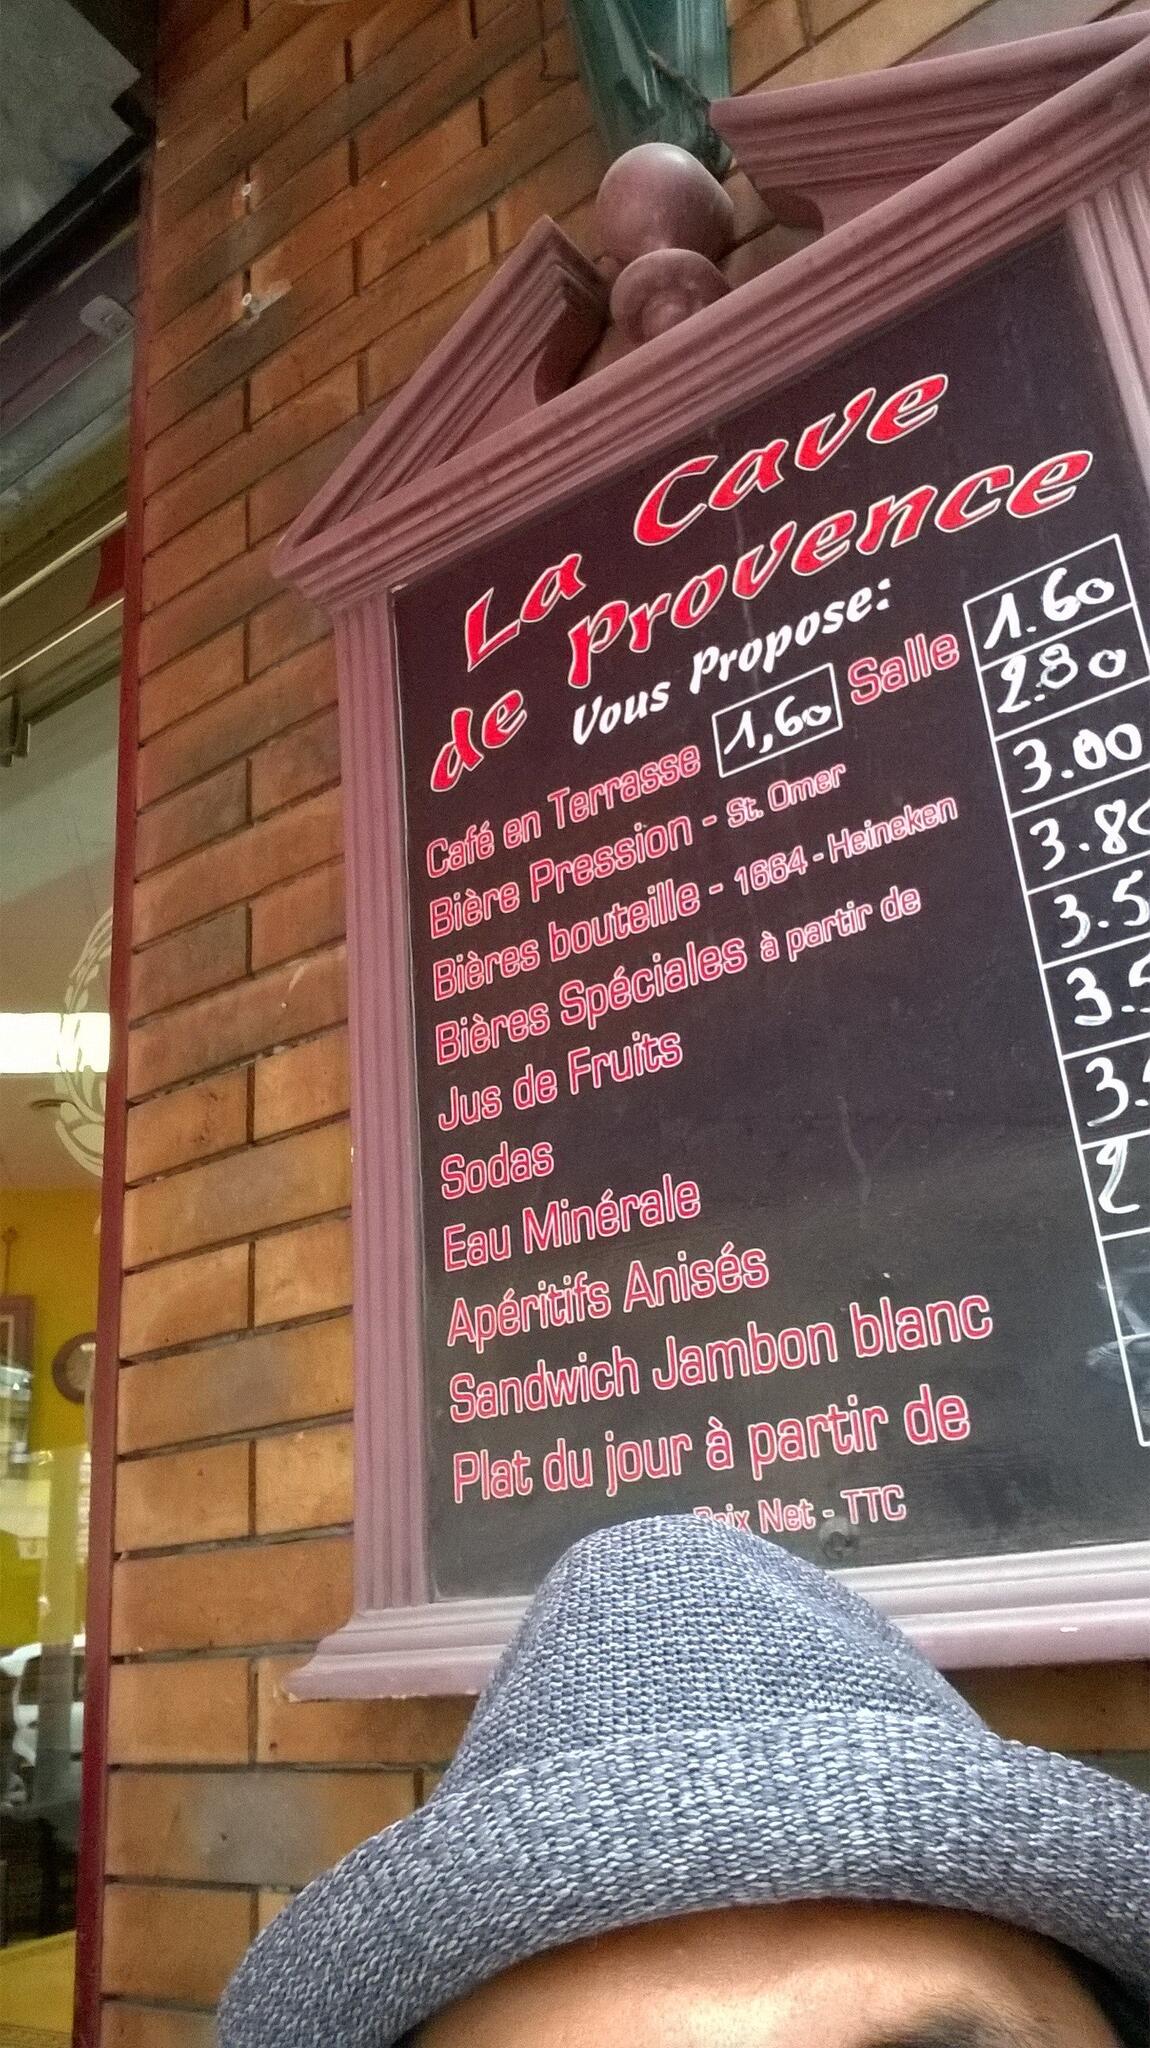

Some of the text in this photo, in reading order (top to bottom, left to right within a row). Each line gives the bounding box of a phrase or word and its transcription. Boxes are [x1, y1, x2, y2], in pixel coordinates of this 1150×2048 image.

[465, 373, 948, 673] La Cave
[430, 450, 1093, 792] de Provence
[983, 567, 1115, 650] 1.60
[572, 680, 671, 745] Vous
[847, 632, 960, 705] Salle
[997, 642, 1126, 713] 2.80
[723, 696, 831, 755] 1,60
[1012, 722, 1143, 793] 3.00
[426, 745, 701, 878] Café en Terrasse
[430, 882, 520, 939] Bière
[529, 816, 693, 902] Pression
[727, 797, 764, 828] St.
[768, 763, 846, 812] Omer
[433, 938, 540, 1001] Bières
[548, 878, 701, 963] bouteille
[734, 846, 807, 895] 1664
[827, 797, 958, 863] Heineken
[435, 886, 921, 1065] Bières Spéciales à partir de
[438, 1031, 683, 1131] Jus de Fruits
[441, 1140, 554, 1200] Sodas
[443, 1173, 701, 1272] Eau Minérale
[447, 1241, 769, 1354] Apéritifs Anisés
[449, 1295, 993, 1423] Sandwich Jambon blanc
[453, 1383, 970, 1503] Plat du jour à partir de
[758, 1498, 815, 1533] Net
[840, 1484, 907, 1525] TTC
